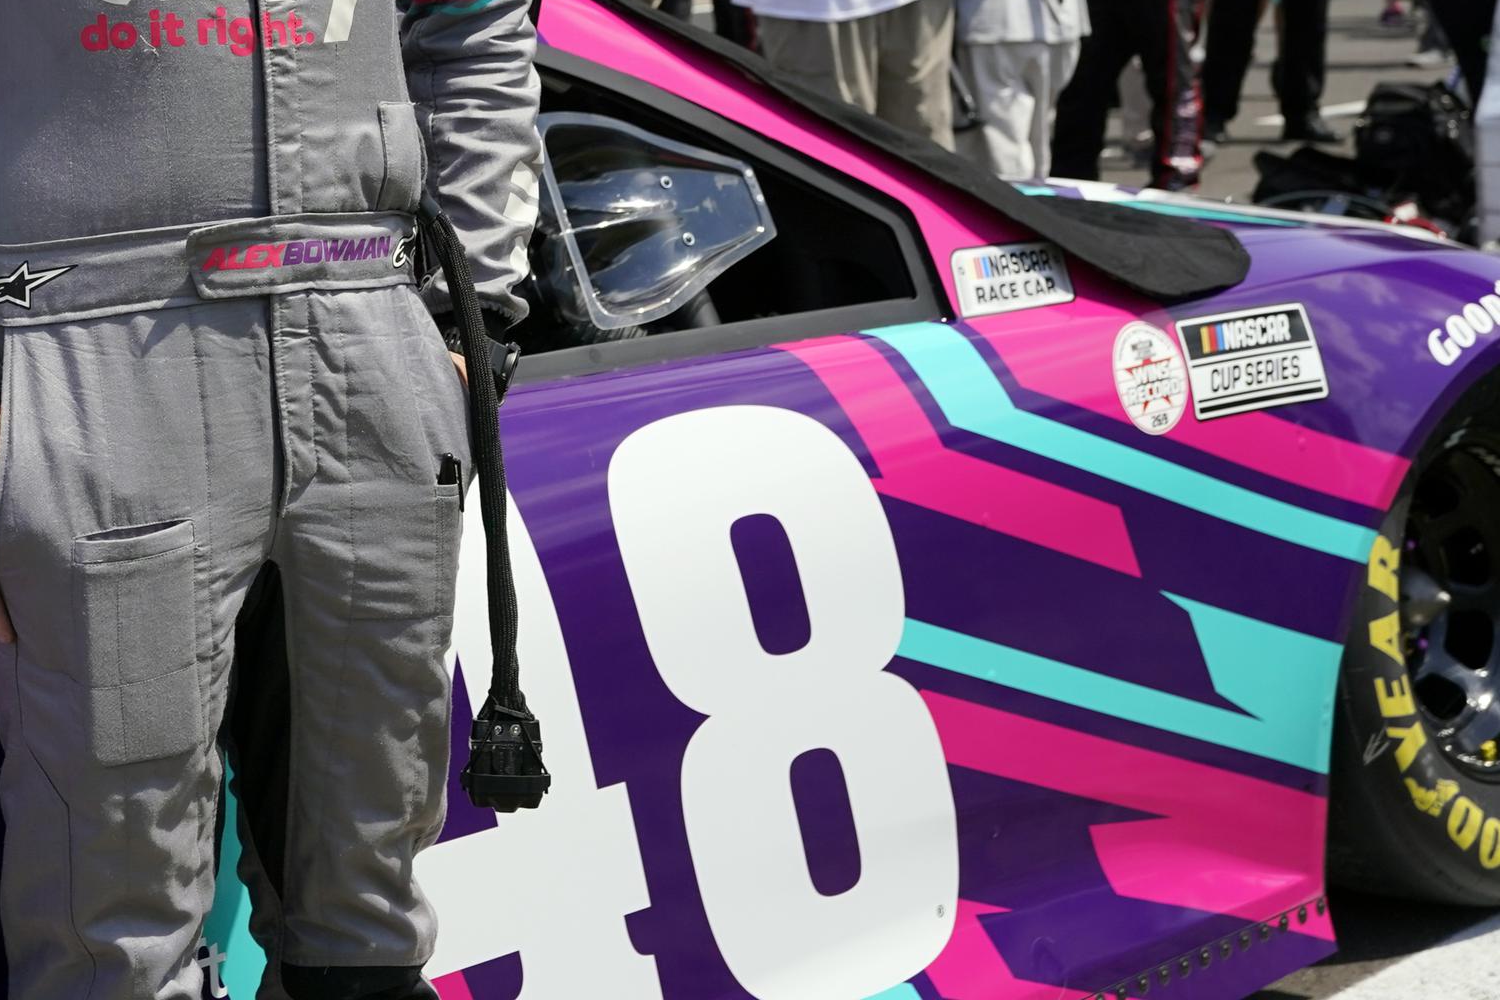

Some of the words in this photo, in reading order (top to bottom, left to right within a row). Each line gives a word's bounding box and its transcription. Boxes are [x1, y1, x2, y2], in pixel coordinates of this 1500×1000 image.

[80, 13, 137, 52] do
[150, 9, 186, 48] it
[197, 4, 315, 57] right.
[989, 250, 1053, 277] NASCAR
[976, 282, 1019, 304] RACE
[1024, 277, 1058, 296] CAR
[1222, 313, 1292, 350] NASCAR
[1211, 365, 1241, 392] CUP
[1245, 355, 1301, 386] SERIES
